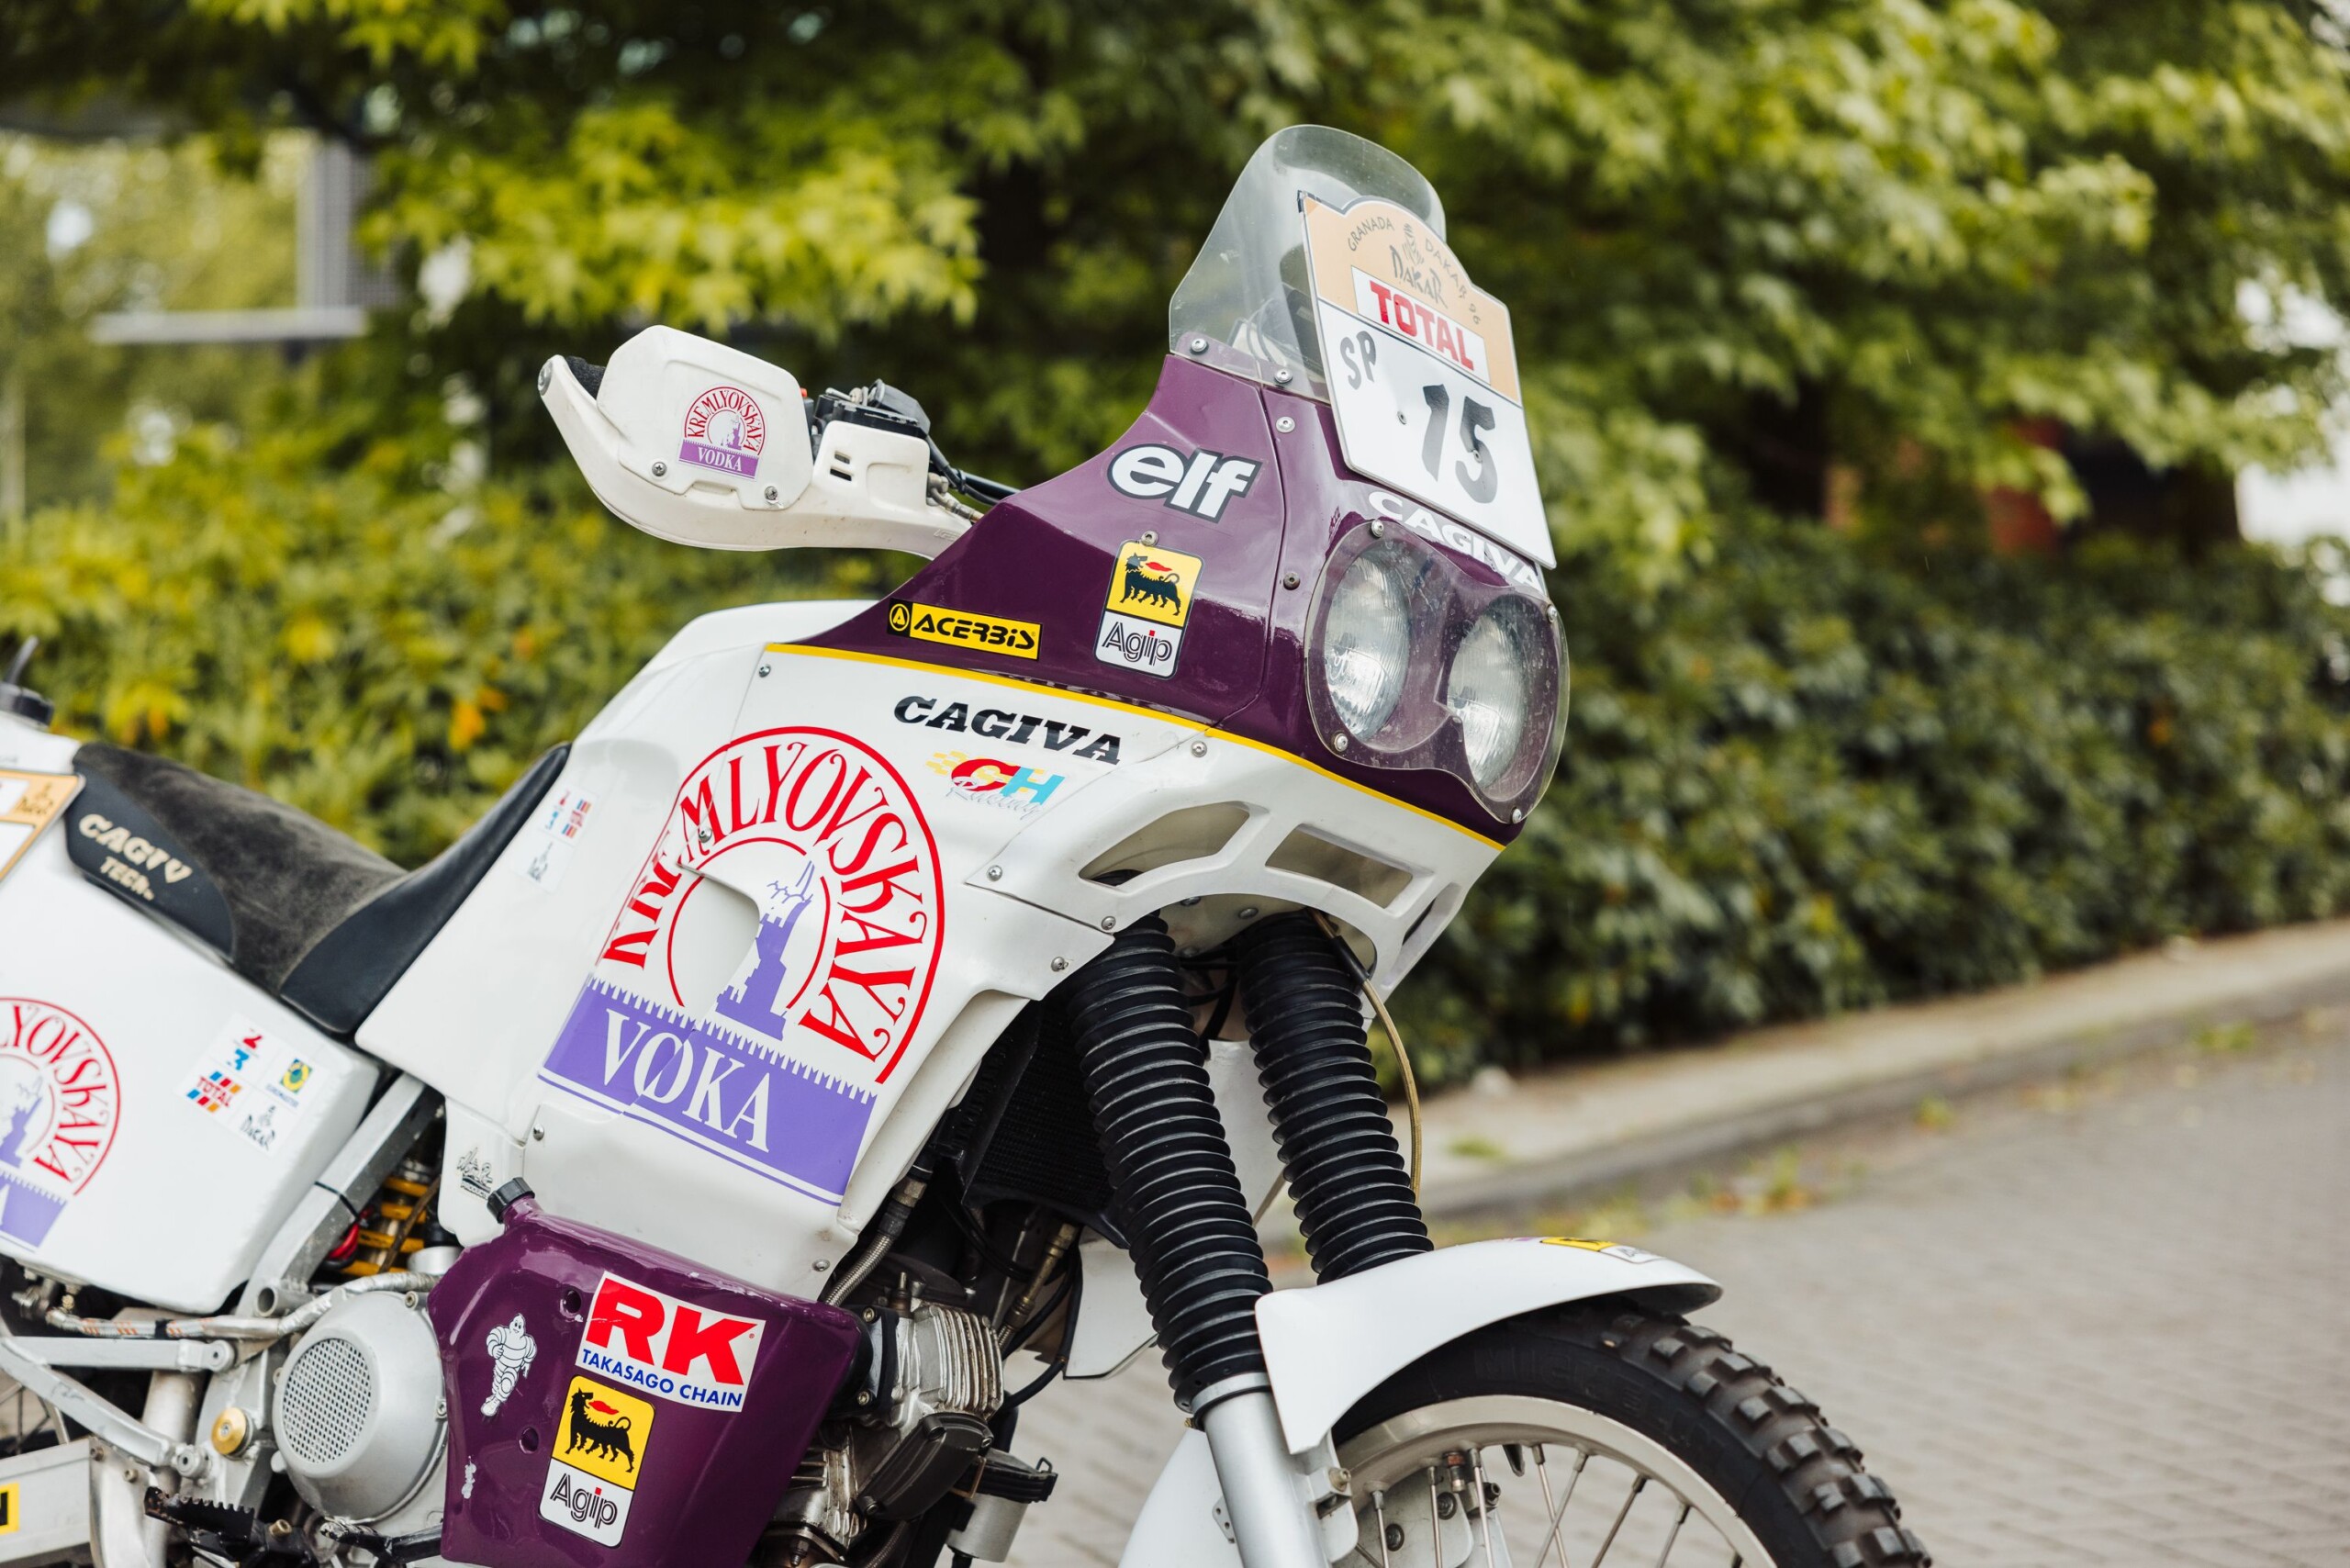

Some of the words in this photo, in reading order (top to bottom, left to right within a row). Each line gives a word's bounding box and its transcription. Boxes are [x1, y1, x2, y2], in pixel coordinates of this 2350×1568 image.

[1348, 217, 1394, 252] GRANADA
[1389, 245, 1449, 309] DAKAR
[1370, 280, 1474, 371] TOTAL
[1339, 330, 1377, 390] SP
[698, 447, 742, 472] VODKA
[1421, 384, 1499, 504] 15
[1110, 445, 1259, 520] elf
[1368, 491, 1545, 597] CAGIVA
[1102, 621, 1172, 667] Agip
[894, 695, 1121, 765] CAGIVA
[604, 1008, 770, 1153] VOKA
[586, 1277, 758, 1386] RK
[582, 1348, 675, 1394] TAKASAGO
[679, 1383, 744, 1407] CHAIN
[550, 1473, 617, 1529] Agip
